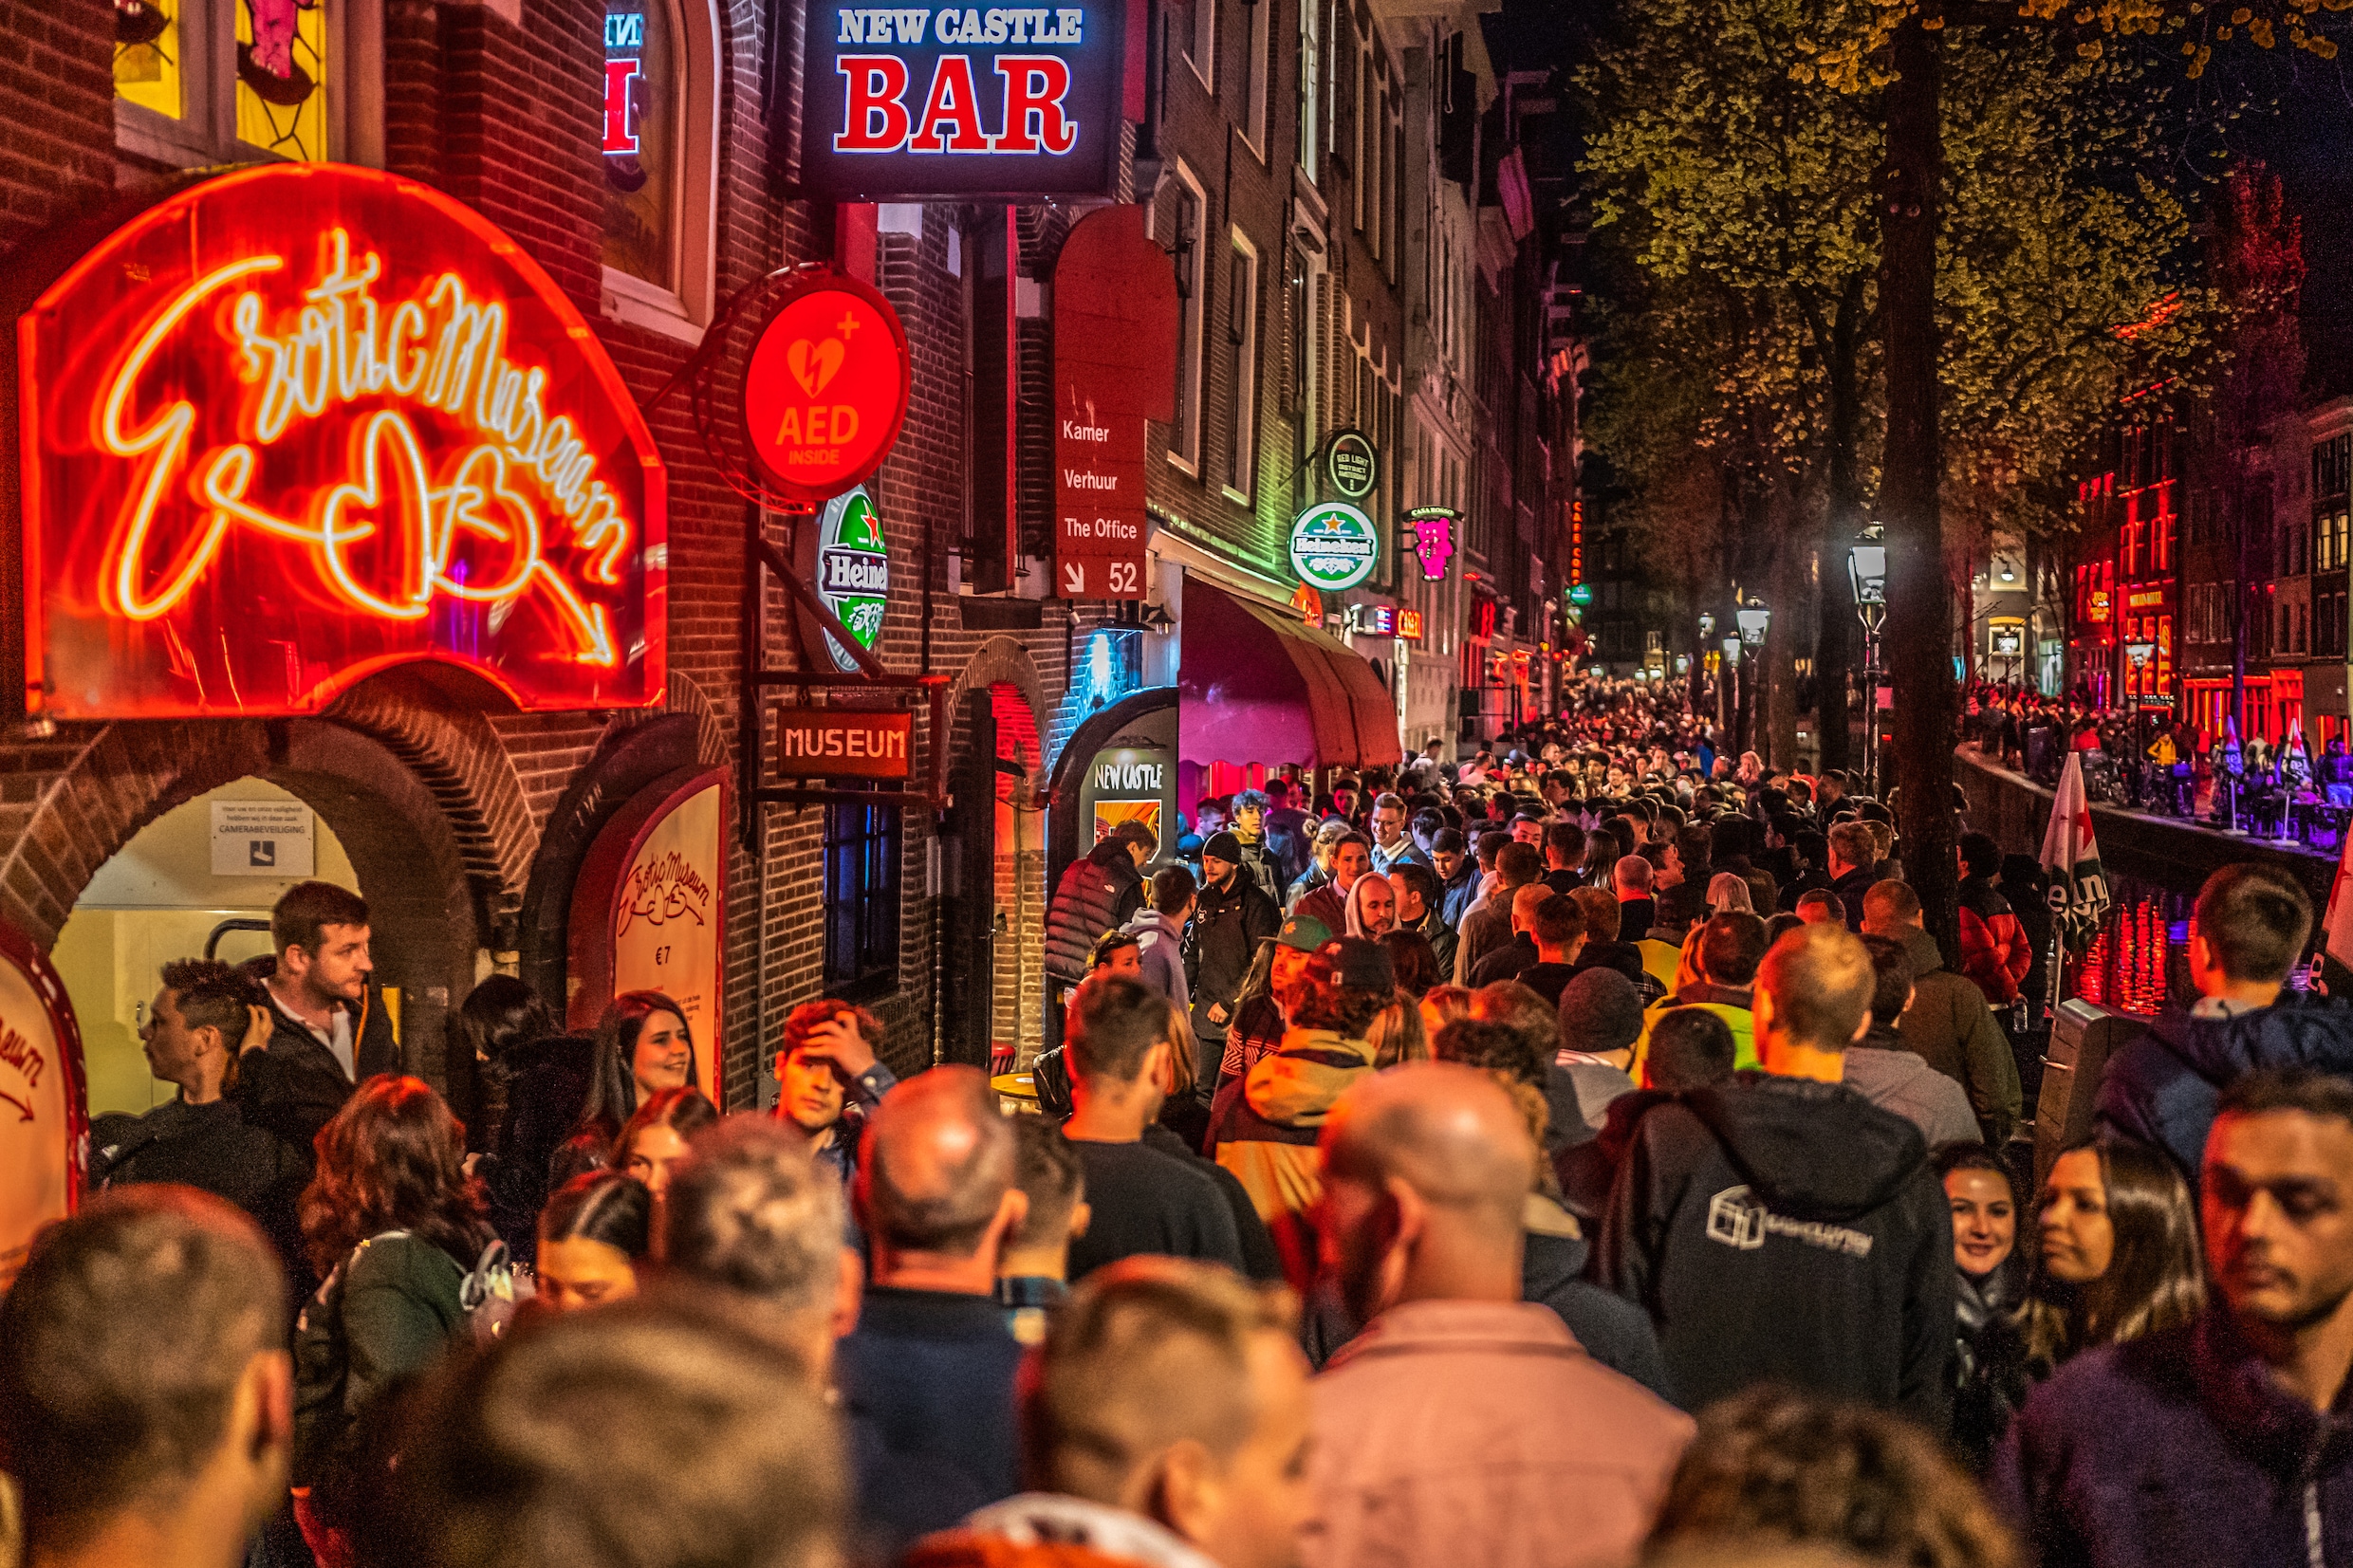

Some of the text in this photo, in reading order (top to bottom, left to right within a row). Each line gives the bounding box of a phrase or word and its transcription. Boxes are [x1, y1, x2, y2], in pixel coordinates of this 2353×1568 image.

[838, 9, 1083, 44] NEW CASTLE
[833, 54, 1079, 155] BAR
[104, 228, 627, 618] Erotic Museum
[775, 405, 859, 445] AED
[1063, 420, 1109, 442] Kamer
[788, 449, 840, 465] INSIDE
[1352, 454, 1369, 467] LIGHT
[1064, 470, 1118, 489] Verhuur
[1411, 507, 1431, 516] CASA
[1572, 501, 1583, 544] CAFE
[1064, 518, 1138, 539] The Office
[1296, 537, 1371, 554] Heineken
[1108, 562, 1138, 593] 52
[786, 729, 905, 758] MUSEUM
[1095, 764, 1163, 791] NEW CASTLE
[219, 824, 306, 834] CAMERABEVEILIGING
[666, 851, 710, 907] Museum
